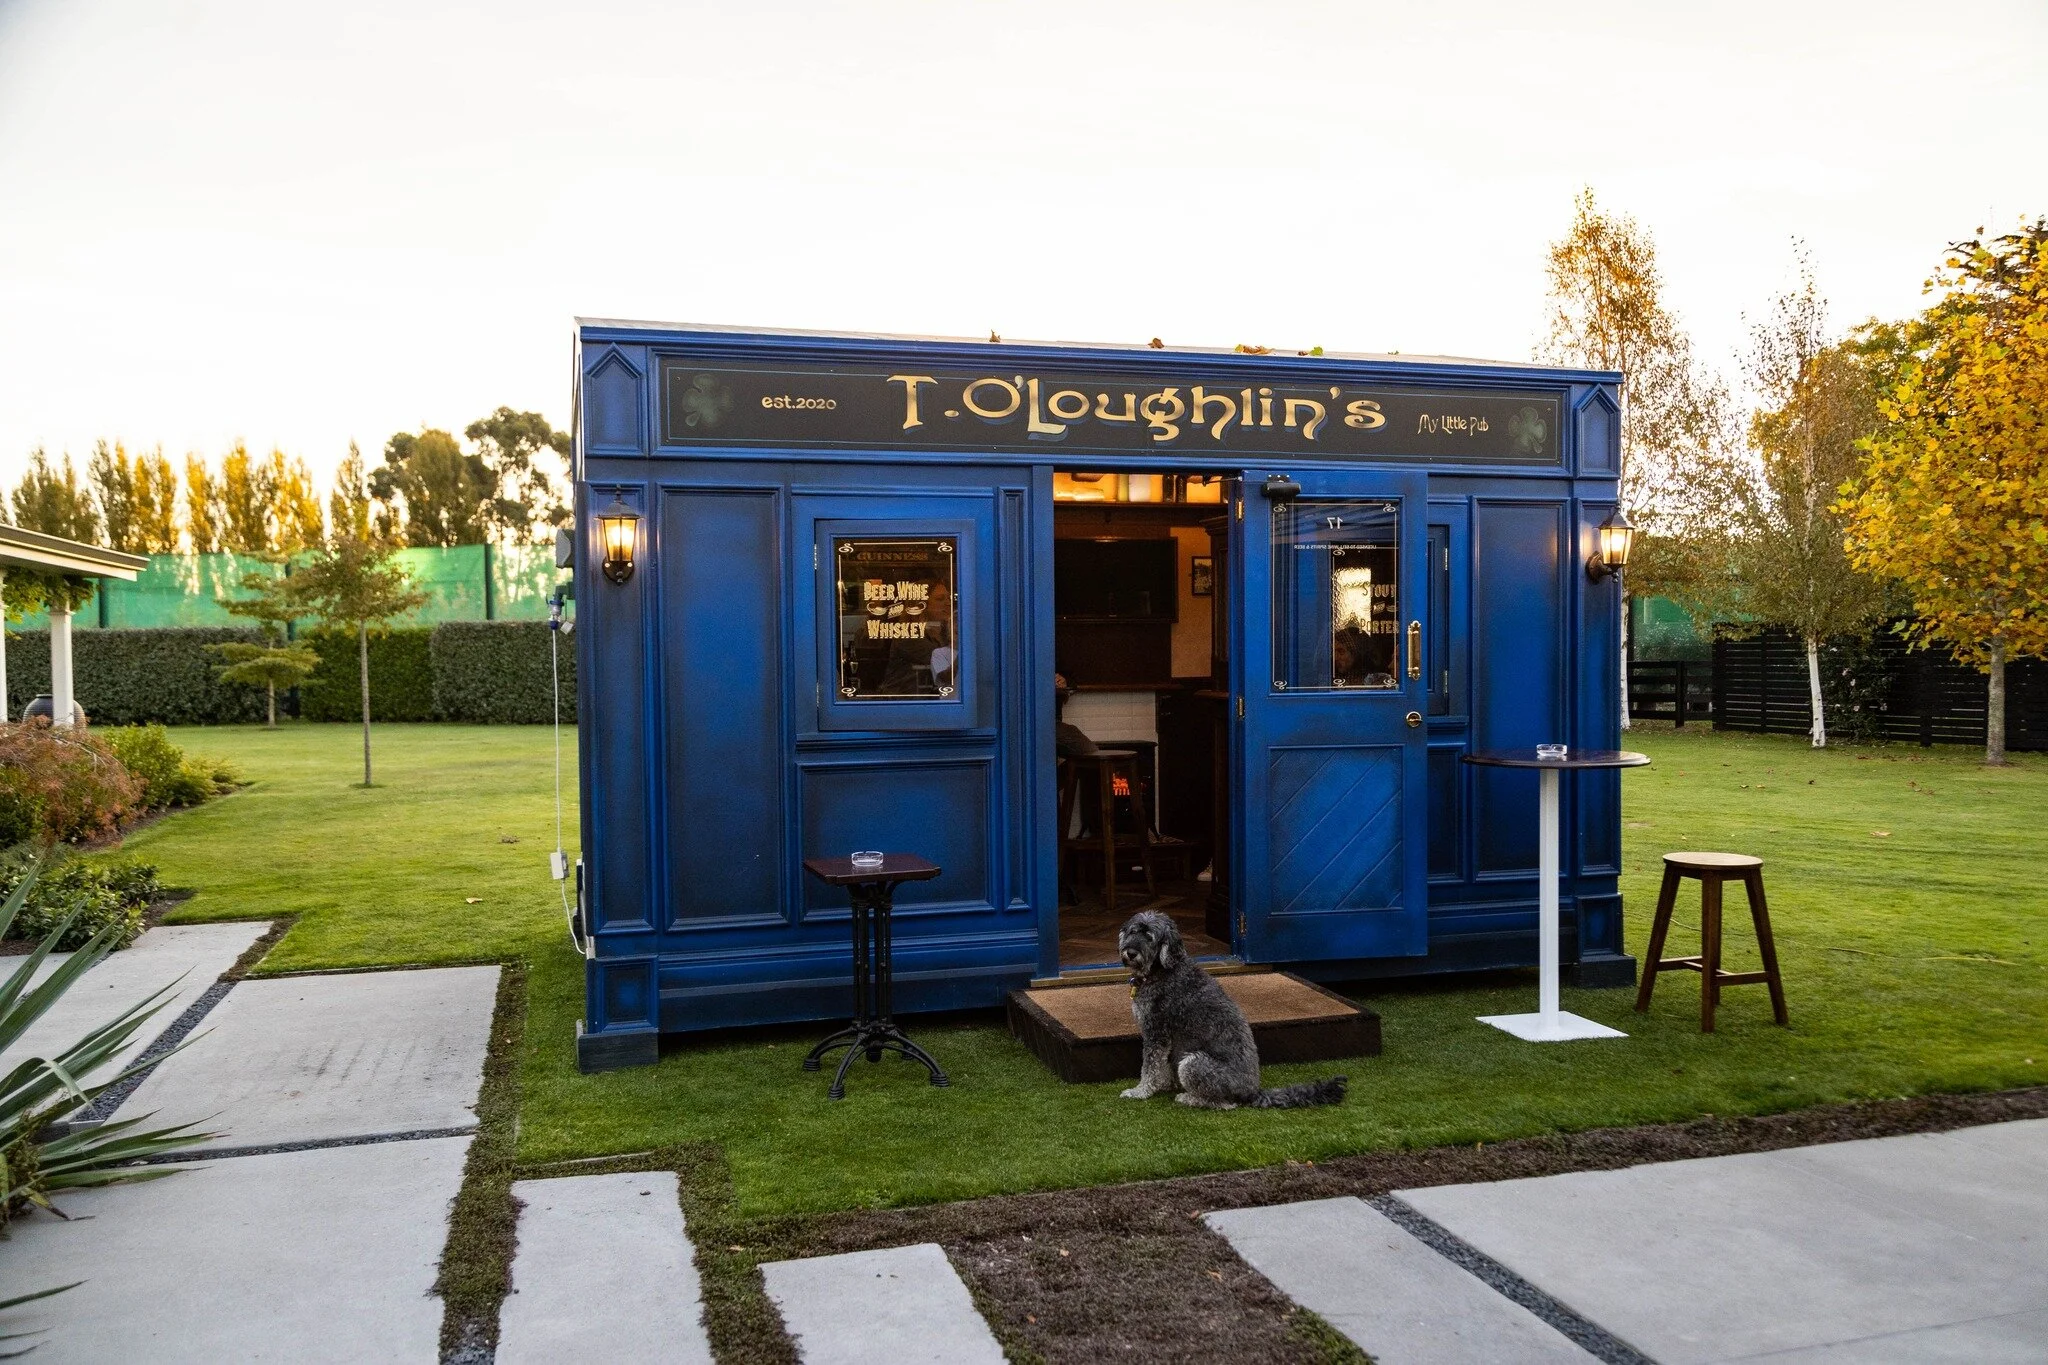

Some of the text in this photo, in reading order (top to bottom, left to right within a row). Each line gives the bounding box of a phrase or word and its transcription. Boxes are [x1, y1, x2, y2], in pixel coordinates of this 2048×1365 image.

[761, 394, 837, 410] est.2020
[963, 374, 1386, 442] O'Loughlin's
[1417, 413, 1489, 437] My Little Pub
[867, 619, 927, 639] WHISKEY
